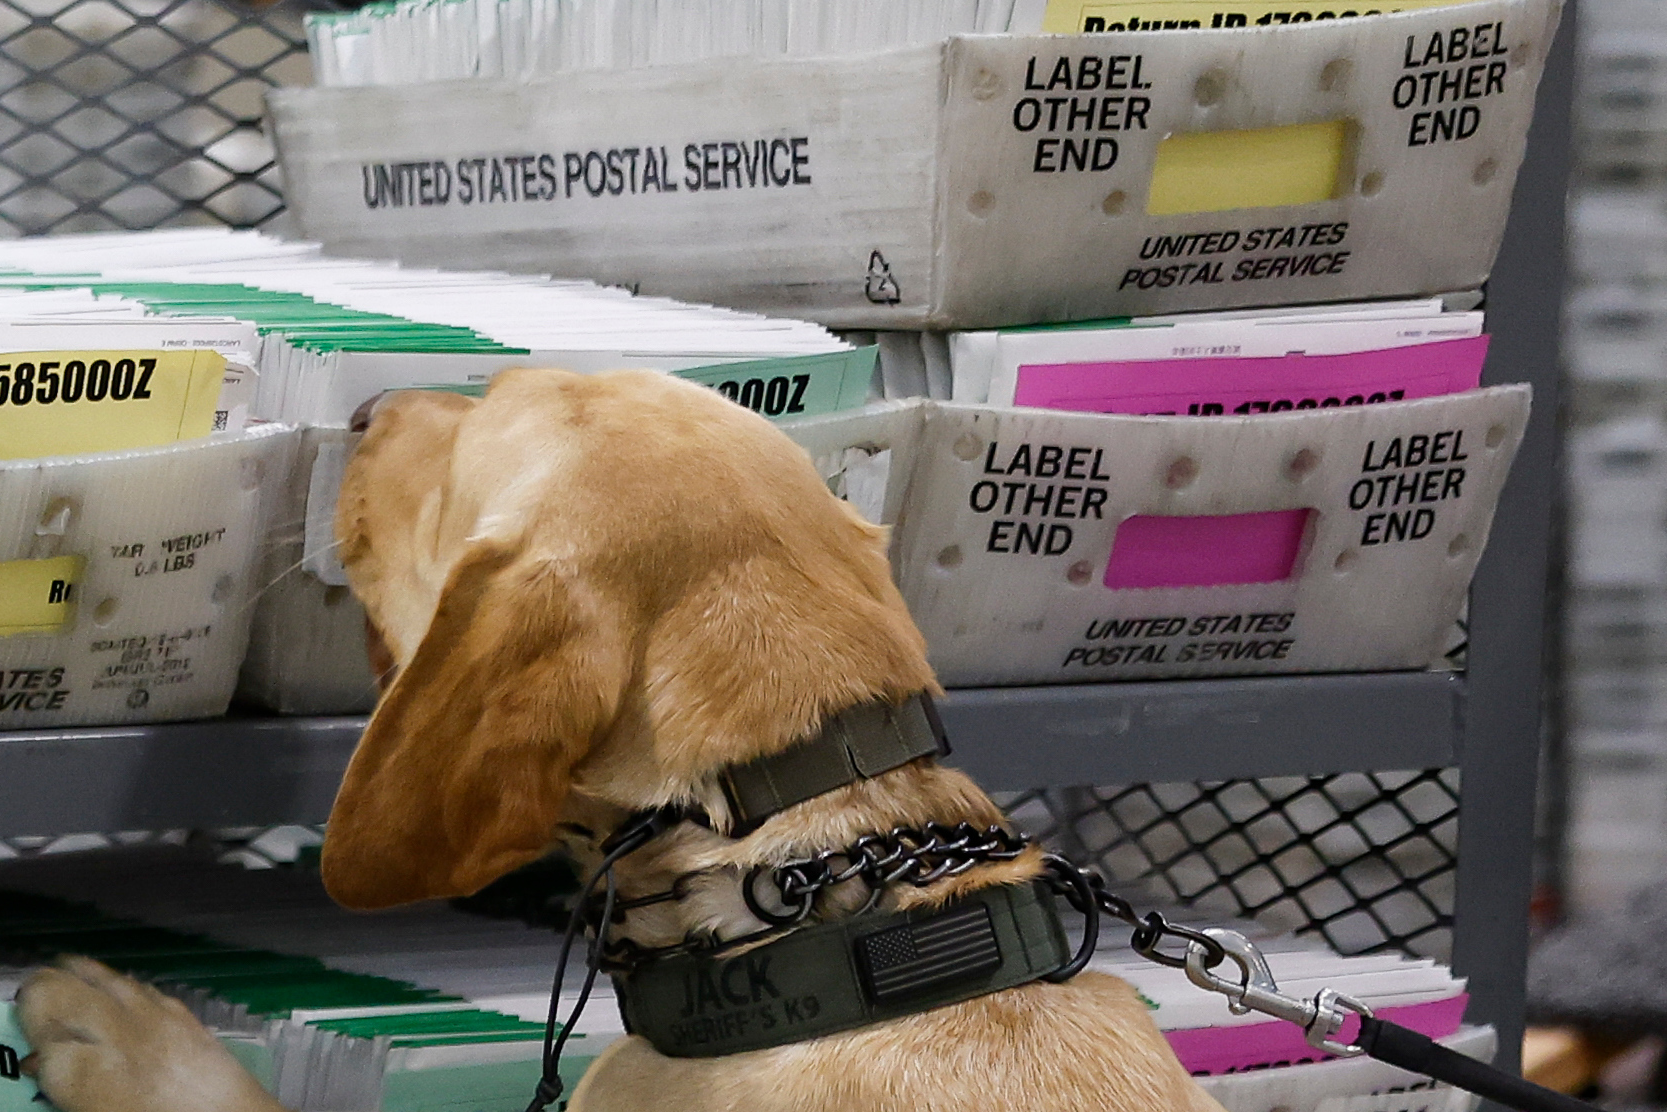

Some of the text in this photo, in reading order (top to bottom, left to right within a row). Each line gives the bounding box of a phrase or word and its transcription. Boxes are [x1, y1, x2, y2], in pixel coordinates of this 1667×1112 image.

[1403, 22, 1508, 69] LABEL
[1024, 56, 1152, 92] LABEL
[1392, 63, 1506, 109] OTHER
[1013, 98, 1151, 131] OTHER
[1408, 106, 1479, 147] END
[362, 138, 811, 208] UNITED STATES POSTAL SERVICE
[1033, 138, 1118, 172] END
[1139, 223, 1347, 259] UNITED STATES
[1117, 252, 1349, 291] POSTAL SERVICE
[984, 443, 1110, 480] LABEL
[1361, 430, 1468, 472] LABEL
[969, 482, 1108, 519] OTHER
[1349, 468, 1464, 510] OTHER
[986, 522, 1072, 556] END
[1360, 508, 1435, 545] END
[1085, 612, 1294, 639] UNITED STATES
[1063, 639, 1295, 667] POSTAL SERVICE
[682, 955, 780, 1017] JACK
[784, 995, 821, 1025] K9
